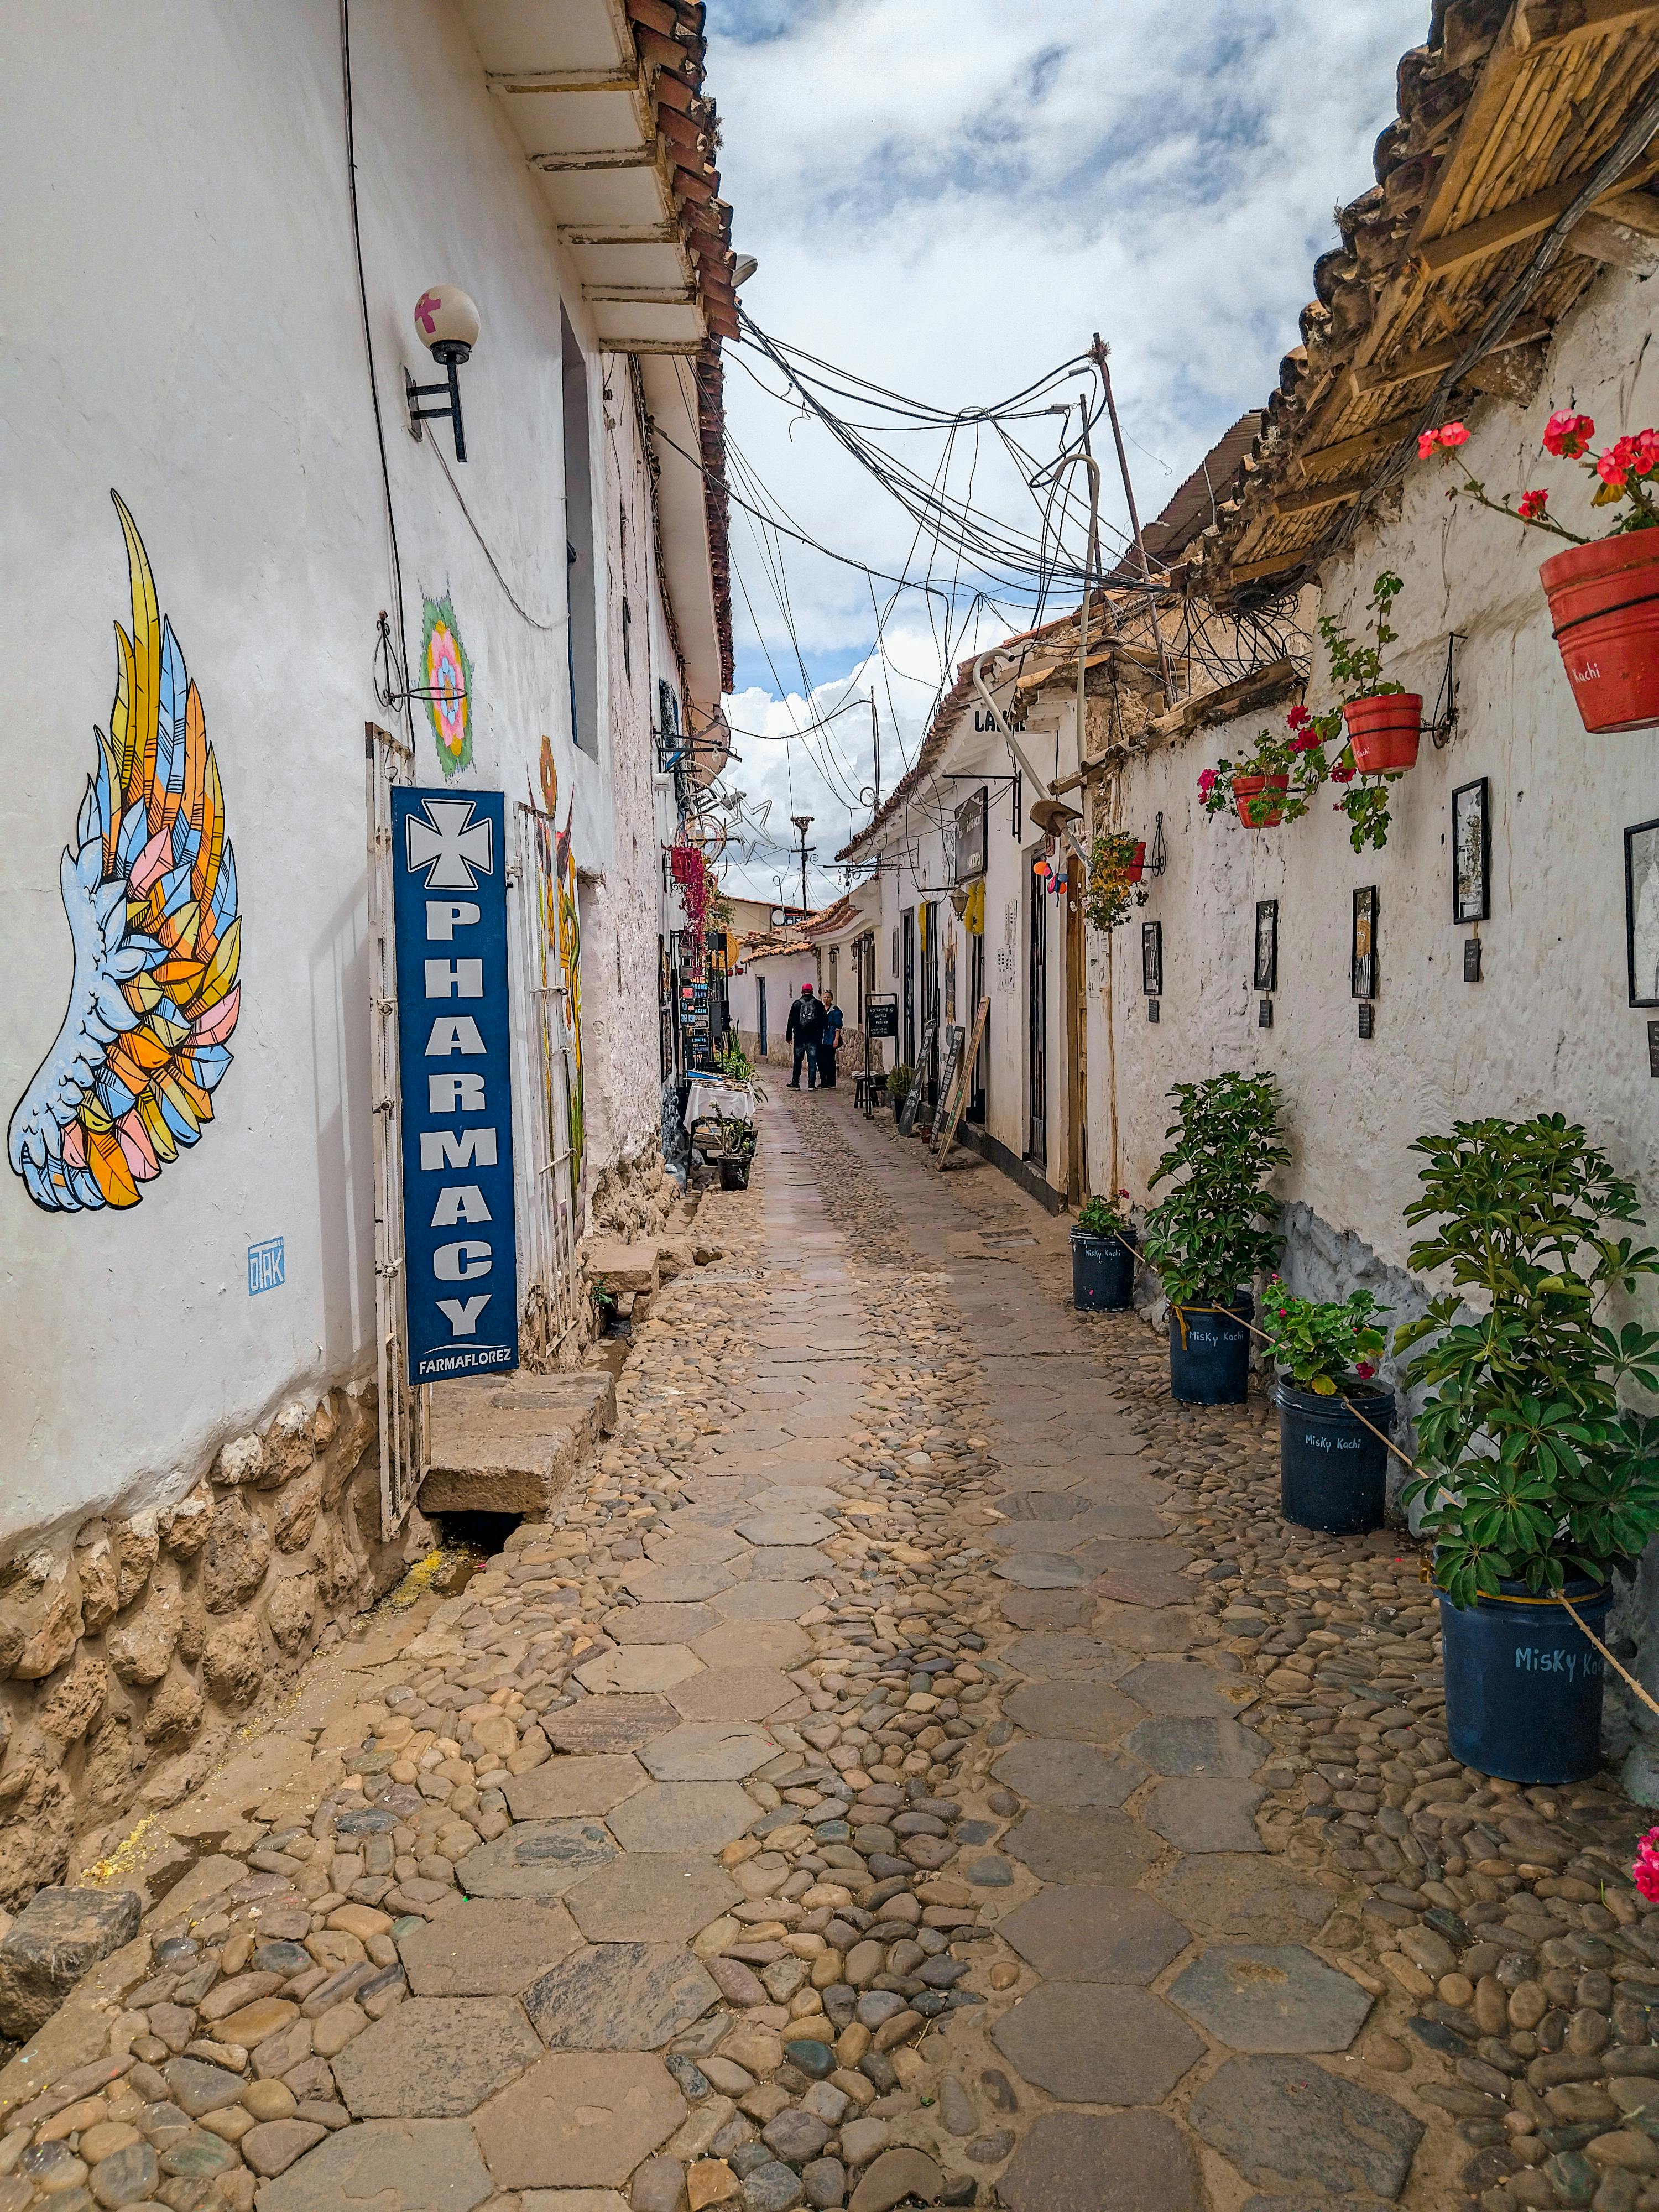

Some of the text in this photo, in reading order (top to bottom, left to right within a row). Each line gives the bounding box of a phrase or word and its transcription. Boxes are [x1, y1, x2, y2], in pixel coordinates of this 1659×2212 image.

[1572, 662, 1600, 683] Kachi
[420, 901, 497, 1336] PHARMACY
[1104, 1249, 1121, 1257] Kachi
[1223, 1330, 1244, 1341] Kachi
[419, 1348, 512, 1375] FARMAFLOREZ
[1337, 1438, 1361, 1450] Kachi
